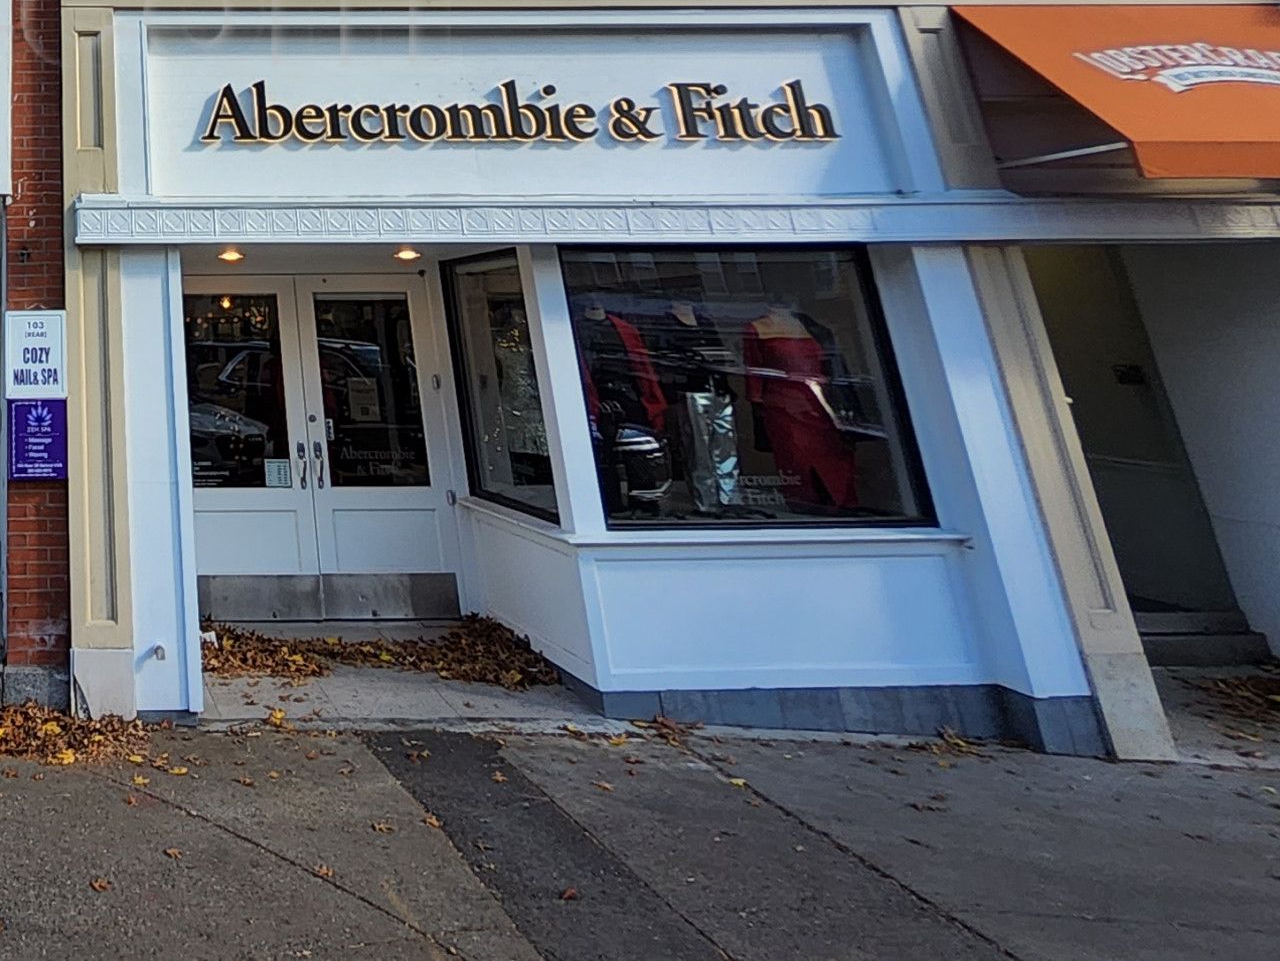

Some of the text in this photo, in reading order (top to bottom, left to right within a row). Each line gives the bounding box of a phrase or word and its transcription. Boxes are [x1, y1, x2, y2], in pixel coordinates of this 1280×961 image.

[200, 78, 843, 142] Abercrombie & Fitch
[27, 321, 45, 329] 103
[22, 347, 51, 364] COZY
[41, 367, 59, 386] SPA
